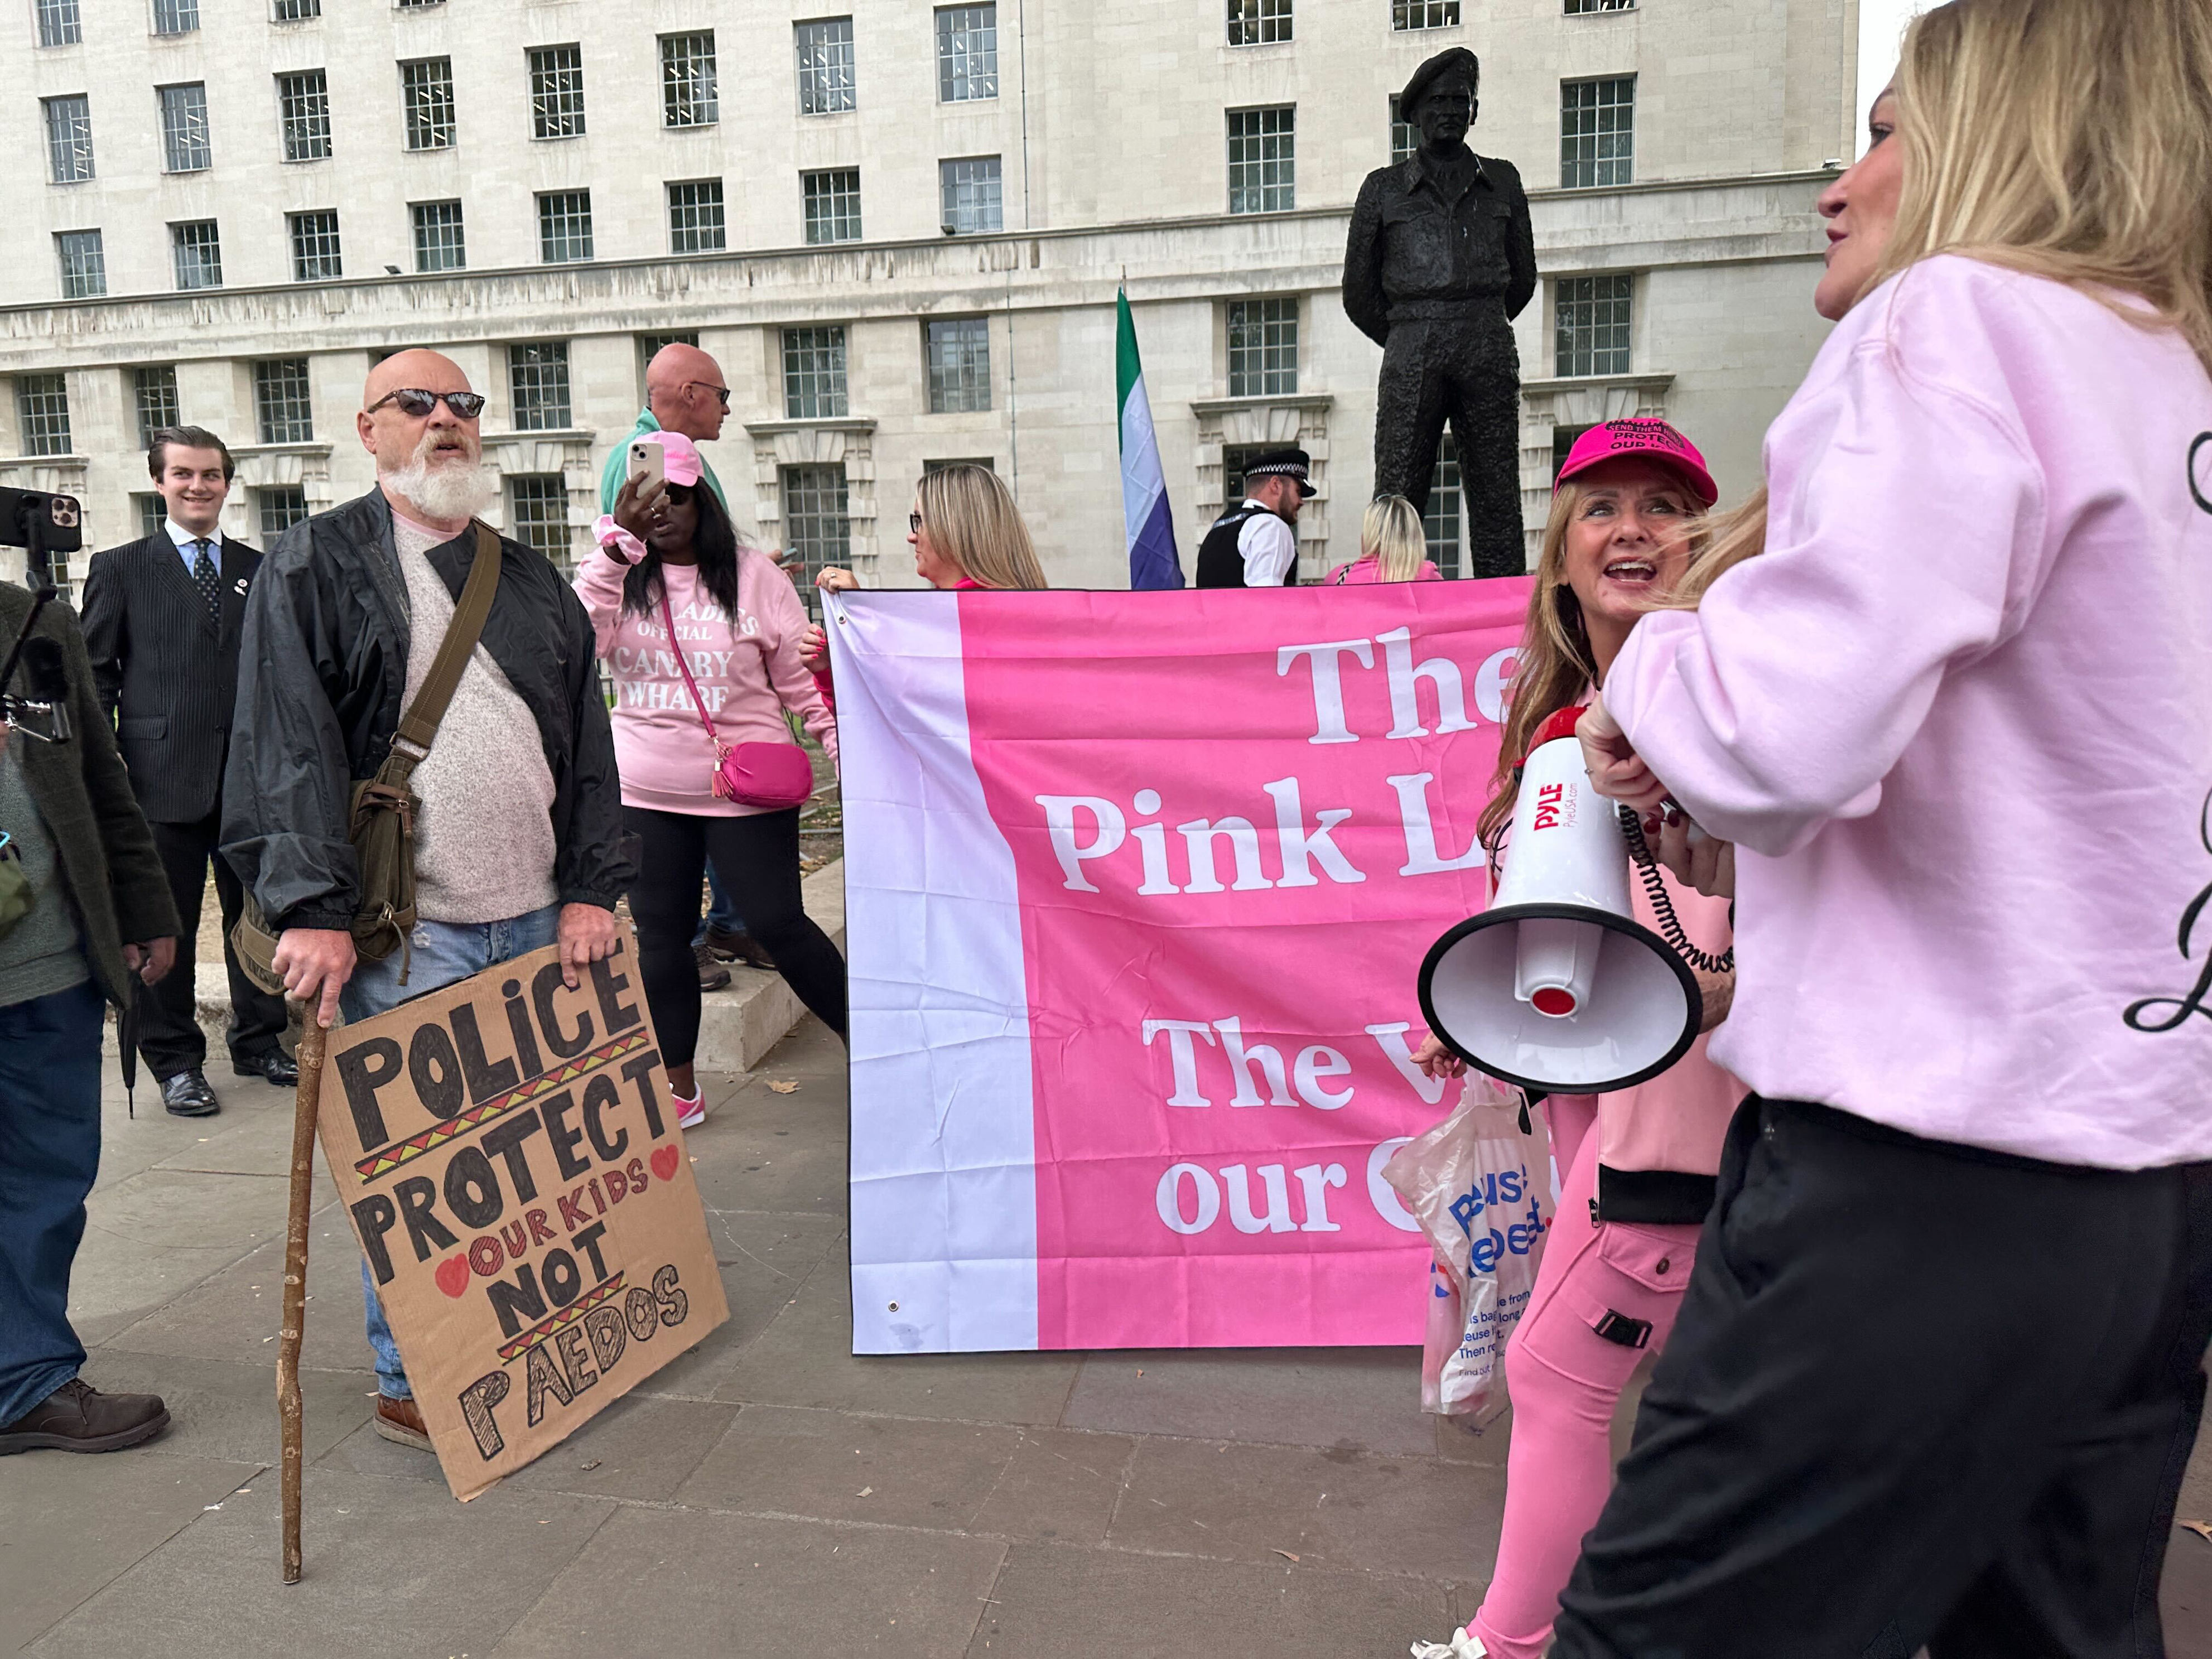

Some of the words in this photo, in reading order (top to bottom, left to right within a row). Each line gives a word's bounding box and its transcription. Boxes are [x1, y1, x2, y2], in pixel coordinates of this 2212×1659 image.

[1614, 432, 1677, 450] PROTEC
[637, 621, 712, 640] OFFCIAL
[615, 647, 734, 677] CANARY
[622, 681, 729, 712] WHARF
[1276, 625, 1529, 745] The
[1534, 783, 1563, 831] PYLE
[1563, 783, 1578, 828] PyleUSA.com
[1034, 776, 1367, 896] Pink
[1141, 1015, 1355, 1110] The
[351, 1049, 665, 1285] PROTECT
[1155, 1162, 1348, 1234] our
[469, 1208, 557, 1276] OUR
[486, 1219, 607, 1339] NOT
[1509, 1290, 1530, 1305] from
[1464, 1329, 1490, 1341] euse
[1499, 1310, 1520, 1323] long
[457, 1264, 688, 1460] PAEDOS
[1459, 1346, 1485, 1359] Then
[1480, 1364, 1490, 1375] out
